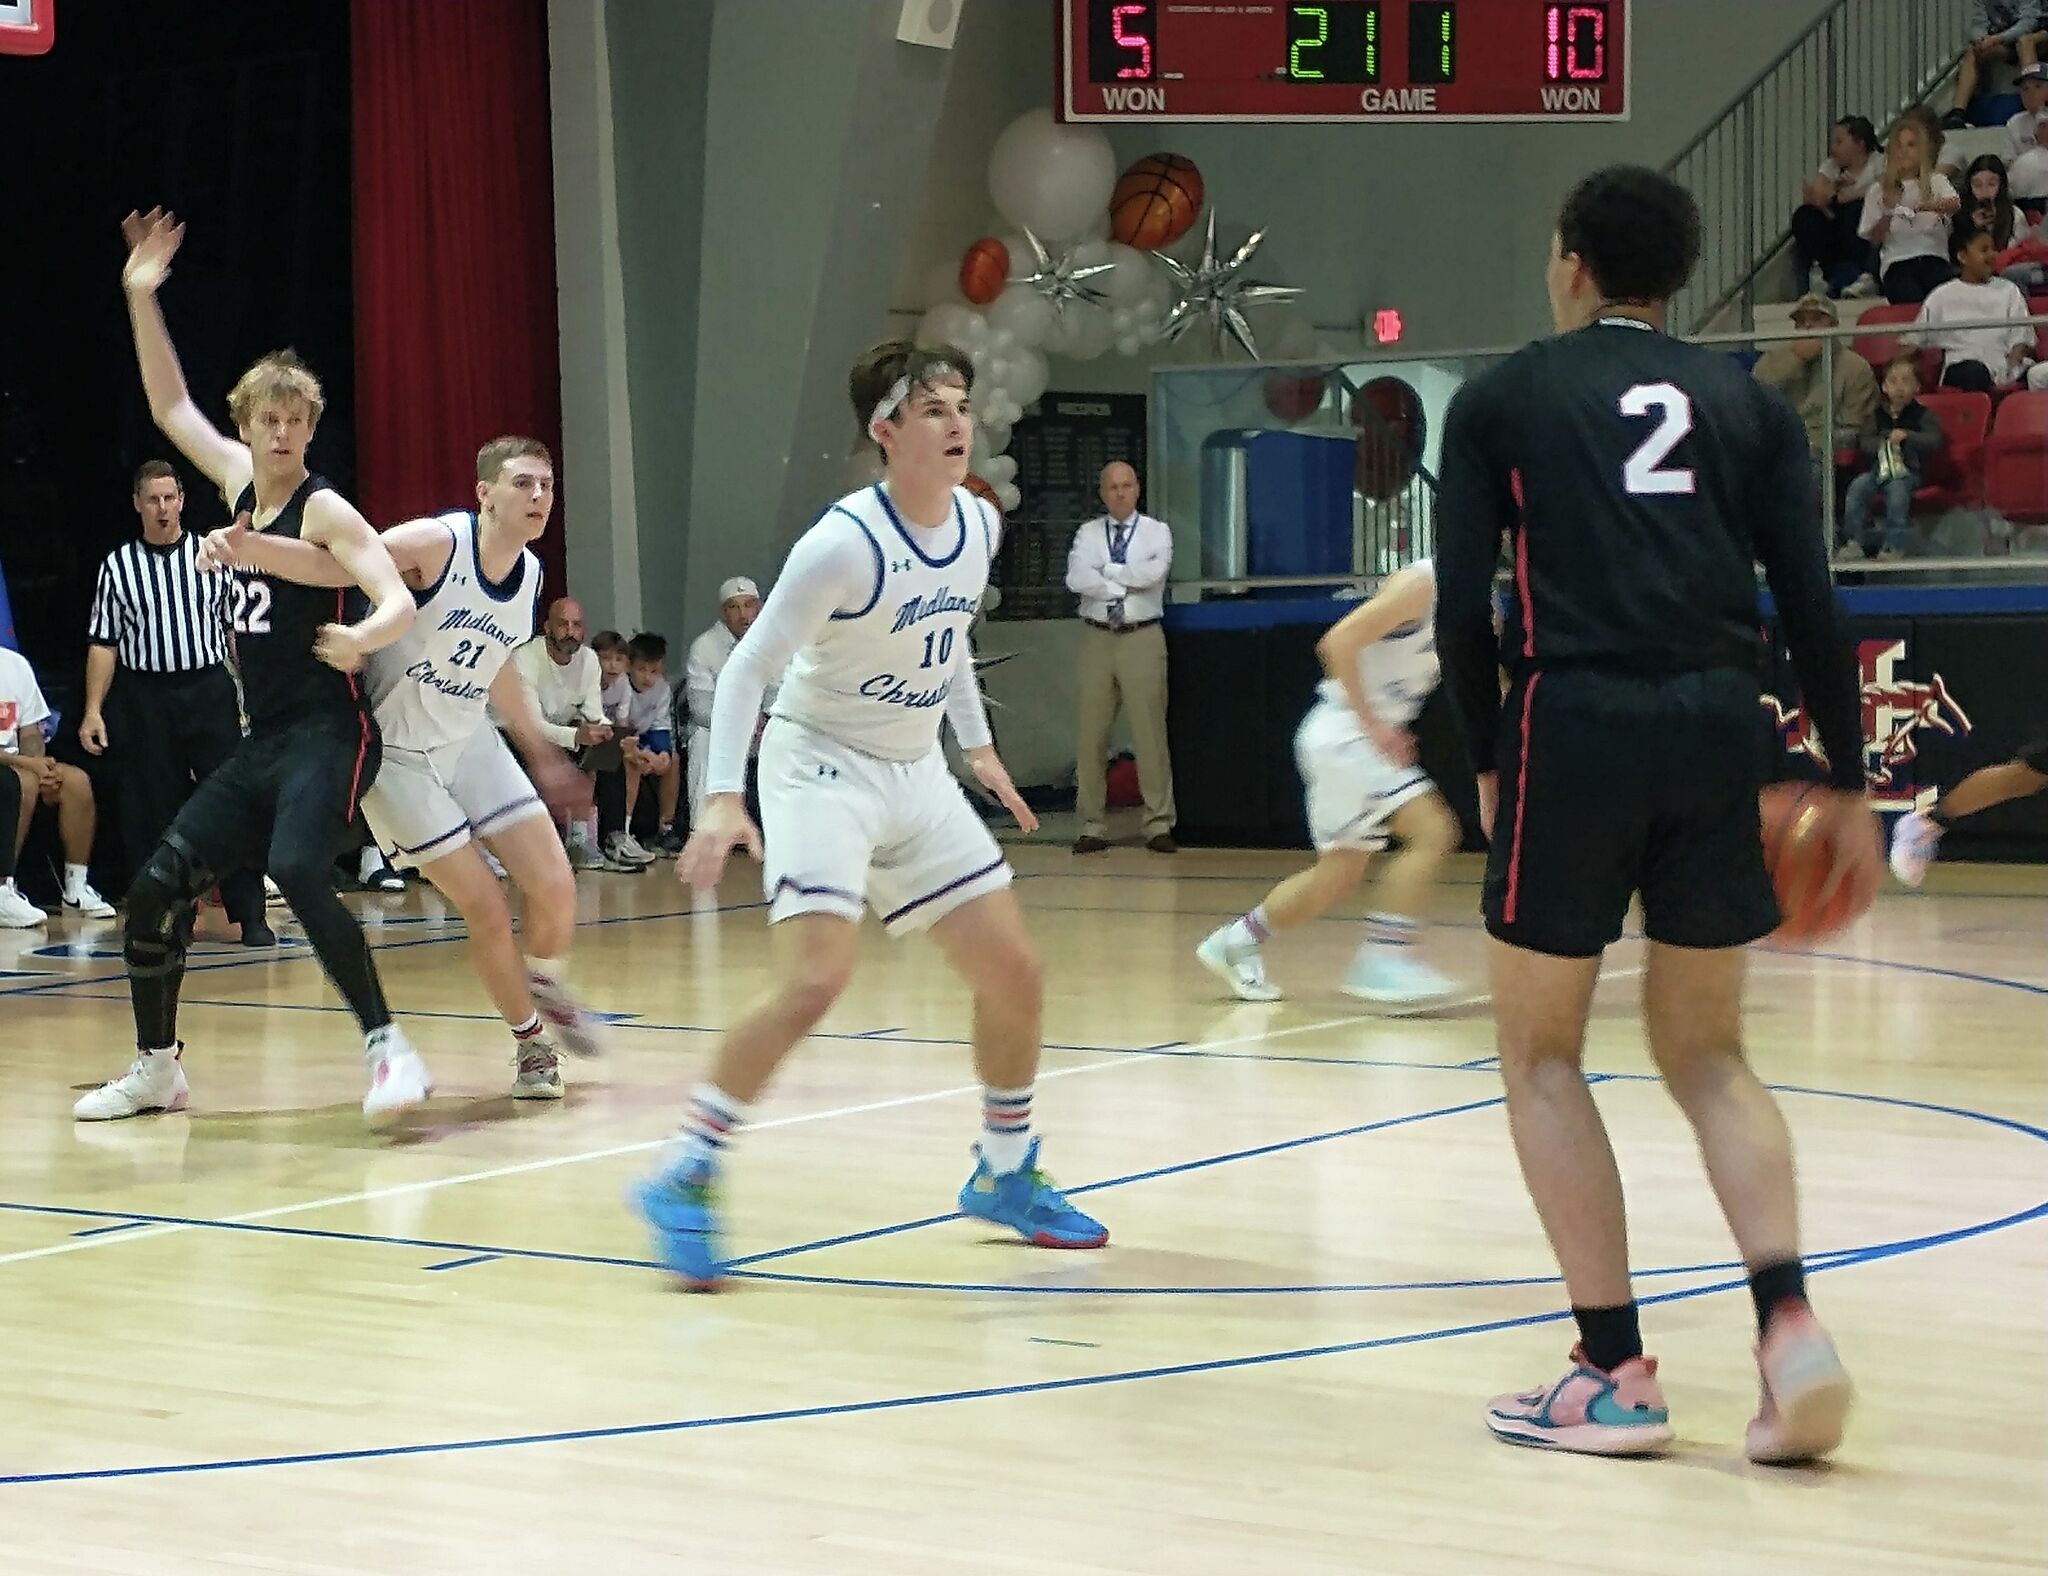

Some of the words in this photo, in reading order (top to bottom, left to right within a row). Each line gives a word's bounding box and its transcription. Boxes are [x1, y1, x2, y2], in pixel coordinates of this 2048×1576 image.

[1112, 5, 1151, 78] 5
[1546, 7, 1604, 79] 10
[1102, 87, 1166, 112] WON
[1361, 87, 1438, 112] GAME
[1540, 87, 1601, 111] WON
[1618, 381, 1697, 494] 2
[231, 579, 271, 633] 22
[437, 607, 519, 647] Midland
[919, 626, 954, 669] 10
[448, 638, 486, 669] 21
